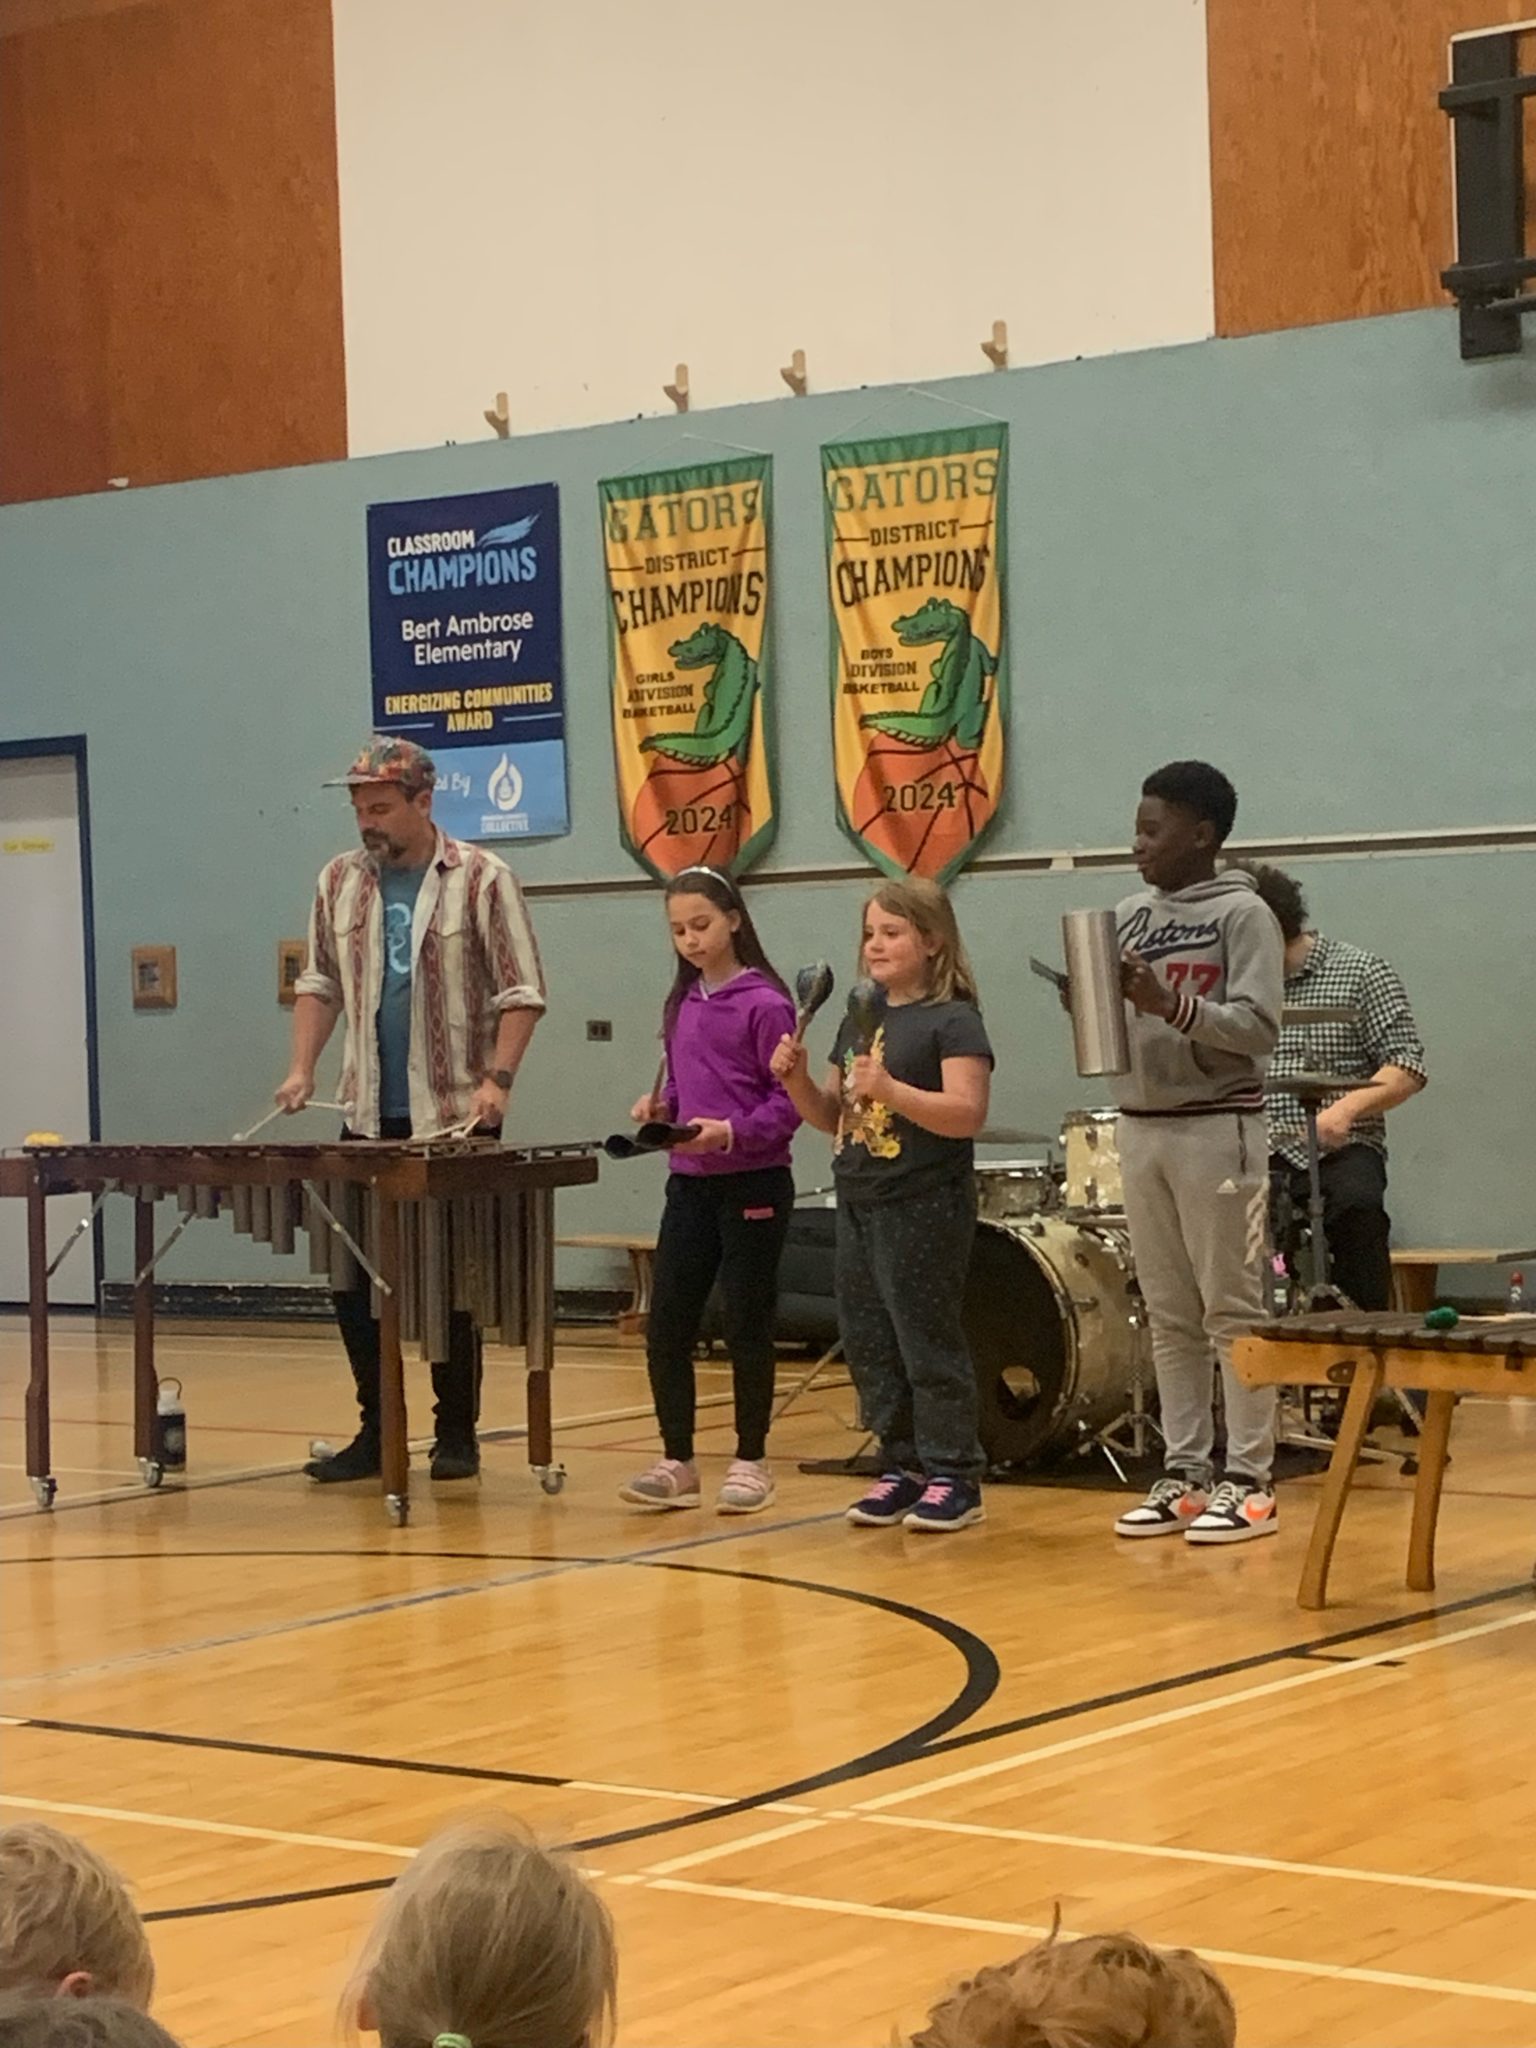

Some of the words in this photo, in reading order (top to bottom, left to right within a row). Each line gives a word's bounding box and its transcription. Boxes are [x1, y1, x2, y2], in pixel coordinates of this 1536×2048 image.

[832, 458, 998, 512] GATORS
[608, 487, 758, 543] GATORS
[388, 529, 475, 558] CLASSROOM
[870, 518, 959, 546] DISTRICT
[388, 546, 537, 595] CHAMPIONS
[645, 547, 729, 575] DISTRICT
[837, 544, 991, 607] CHAMPIONS
[612, 571, 763, 635] CHAMPIONS
[402, 617, 441, 642] Bert
[446, 611, 533, 637] Ambrose
[414, 638, 522, 667] Elementary
[861, 648, 894, 660] BOYS
[636, 671, 675, 684] GIRLS
[850, 661, 917, 677] DIVISION
[385, 691, 461, 715] ENERGIZING
[464, 682, 553, 709] COMMUNITIES
[447, 710, 493, 733] AWARD
[451, 772, 471, 798] By
[882, 781, 955, 812] 2024
[666, 804, 732, 836] 2024
[1117, 906, 1220, 958] Pistons
[1166, 963, 1221, 997] 77
